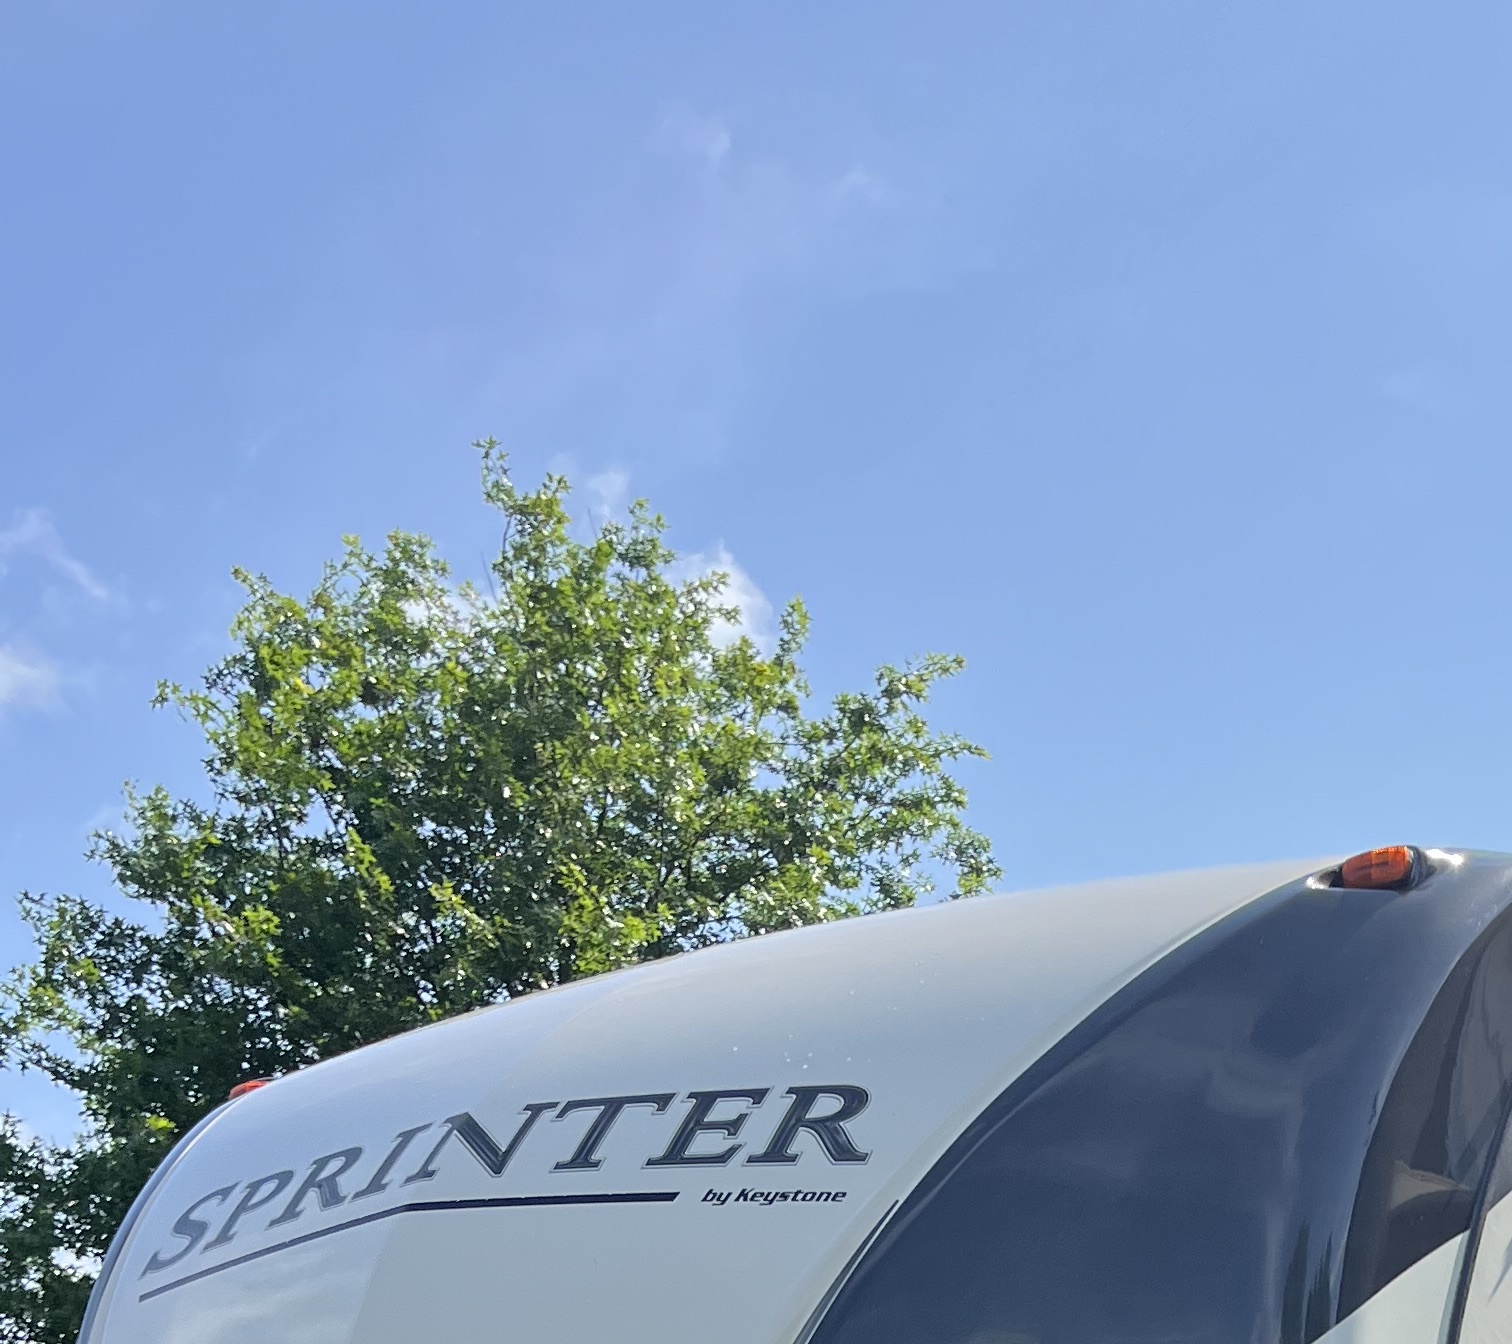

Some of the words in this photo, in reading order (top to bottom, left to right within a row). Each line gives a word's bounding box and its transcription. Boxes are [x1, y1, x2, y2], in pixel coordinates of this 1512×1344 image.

[138, 1083, 874, 1281] SPRINTER
[700, 1188, 733, 1206] by
[733, 1187, 848, 1206] Keystone
